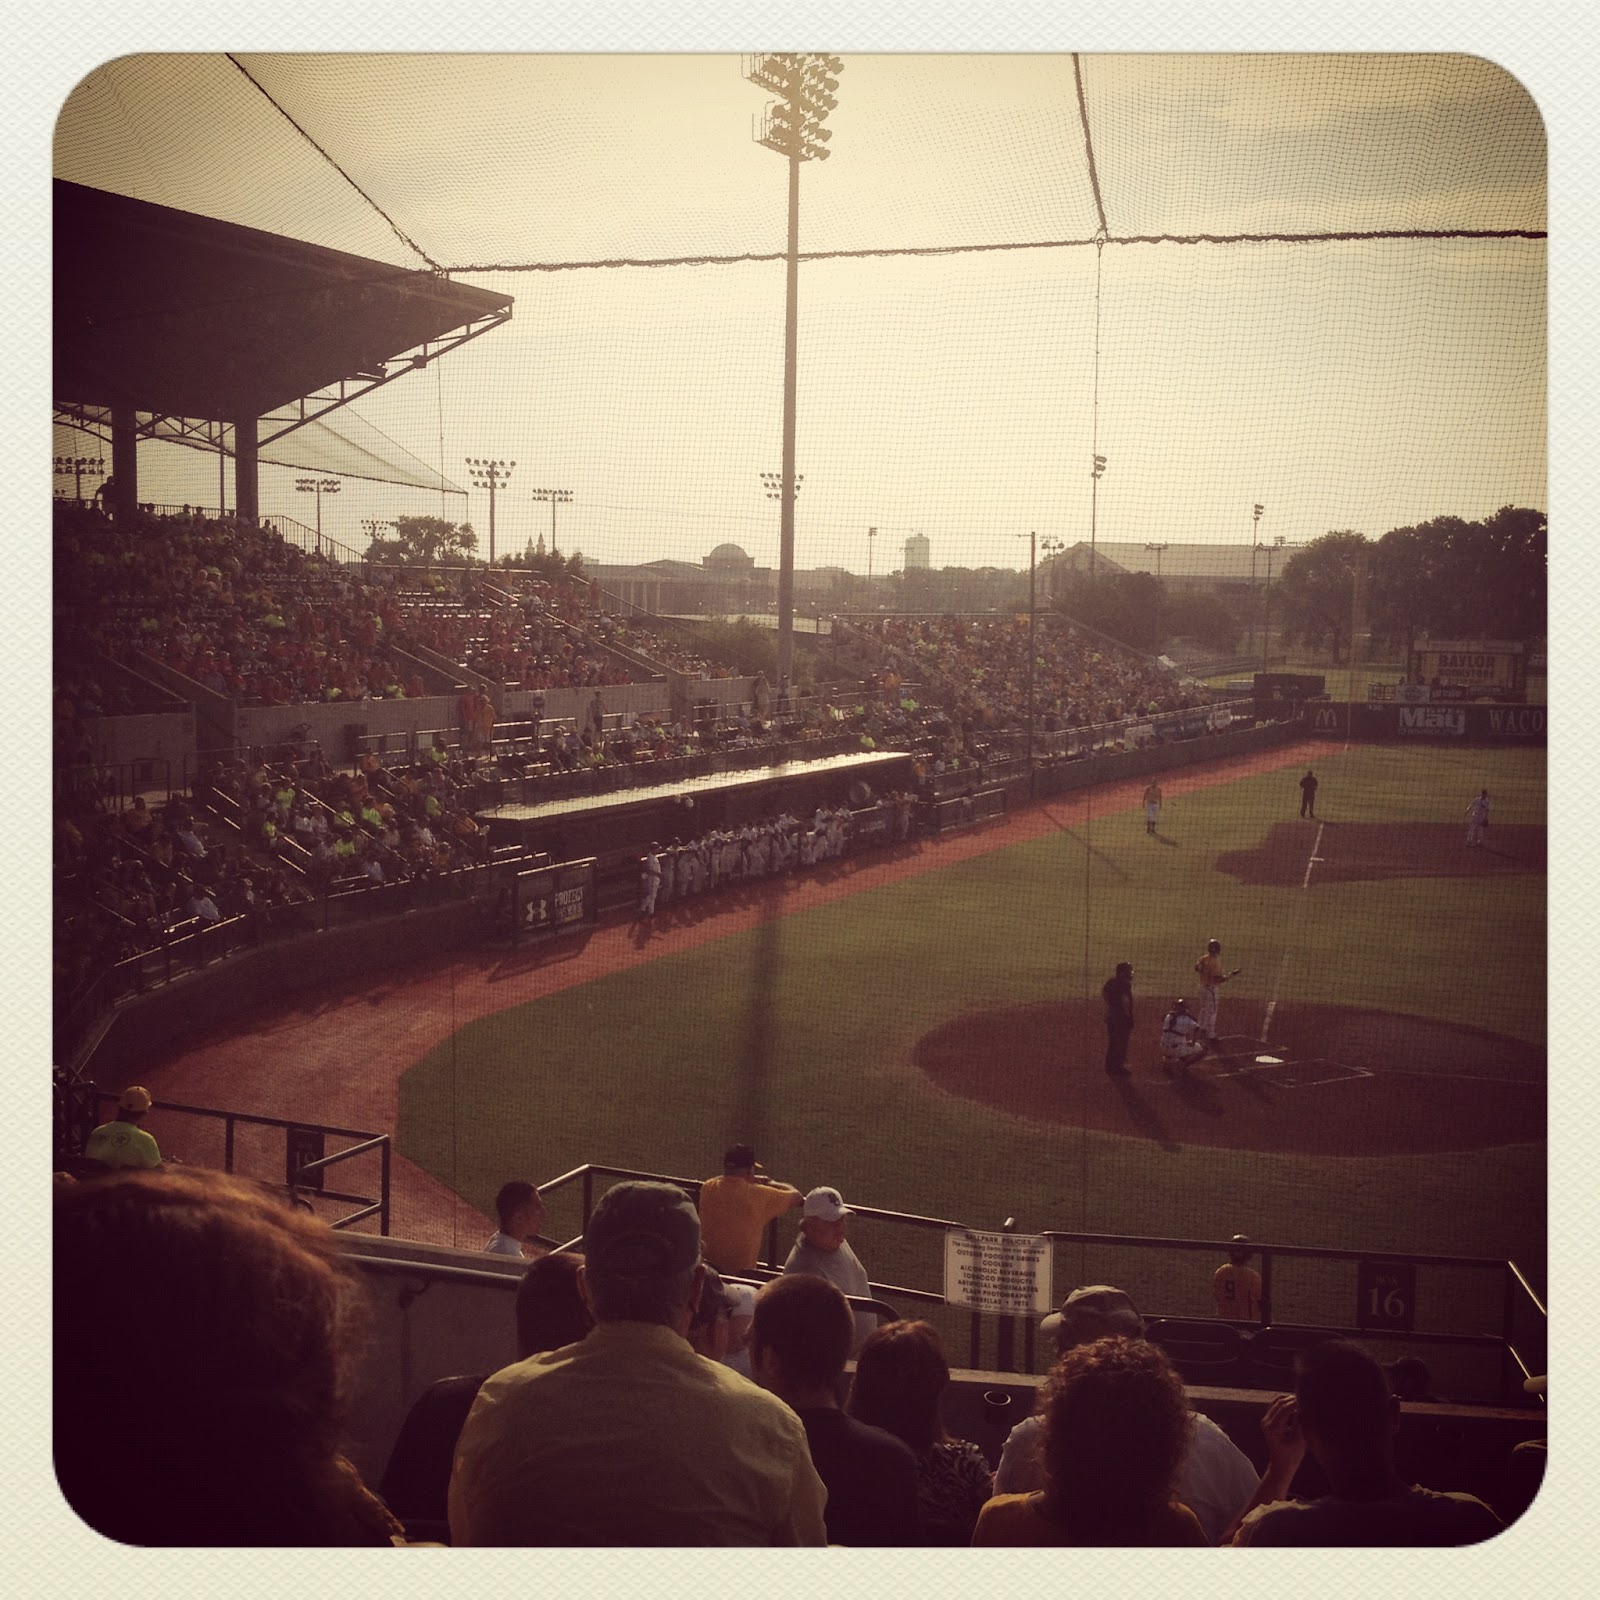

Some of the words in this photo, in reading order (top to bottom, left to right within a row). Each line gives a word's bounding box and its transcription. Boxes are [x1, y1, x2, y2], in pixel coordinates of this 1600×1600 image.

[1438, 654, 1496, 668] BAYLOR
[1437, 668, 1495, 678] BOOKSTORE
[1399, 706, 1466, 736] May
[554, 886, 583, 908] PROTECT
[961, 1241, 986, 1252] following
[986, 1244, 1001, 1252] items
[965, 1233, 999, 1243] BALLPARK
[1001, 1237, 1032, 1246] POLICIES
[956, 1249, 983, 1259] OUTSIDE
[984, 1252, 1003, 1260] FOOD
[1016, 1255, 1040, 1263] DRINKS
[982, 1259, 1013, 1268] COOLERS
[960, 1264, 998, 1275] ALCOHOLIC
[999, 1269, 1036, 1278] BEVERAGES
[963, 1272, 996, 1282] TOBACCO
[997, 1276, 1033, 1285] PRODUCTS
[957, 1279, 991, 1289] ARTIFICIAL
[992, 1283, 1039, 1293] NOISEMAKERS
[962, 1286, 982, 1295] FLASH
[982, 1290, 1033, 1299] PHOTOGRAPHY
[1225, 1279, 1236, 1301] 9
[966, 1295, 1002, 1305] UMBRELLAS
[1013, 1299, 1030, 1307] PETS
[1367, 1286, 1405, 1319] 16
